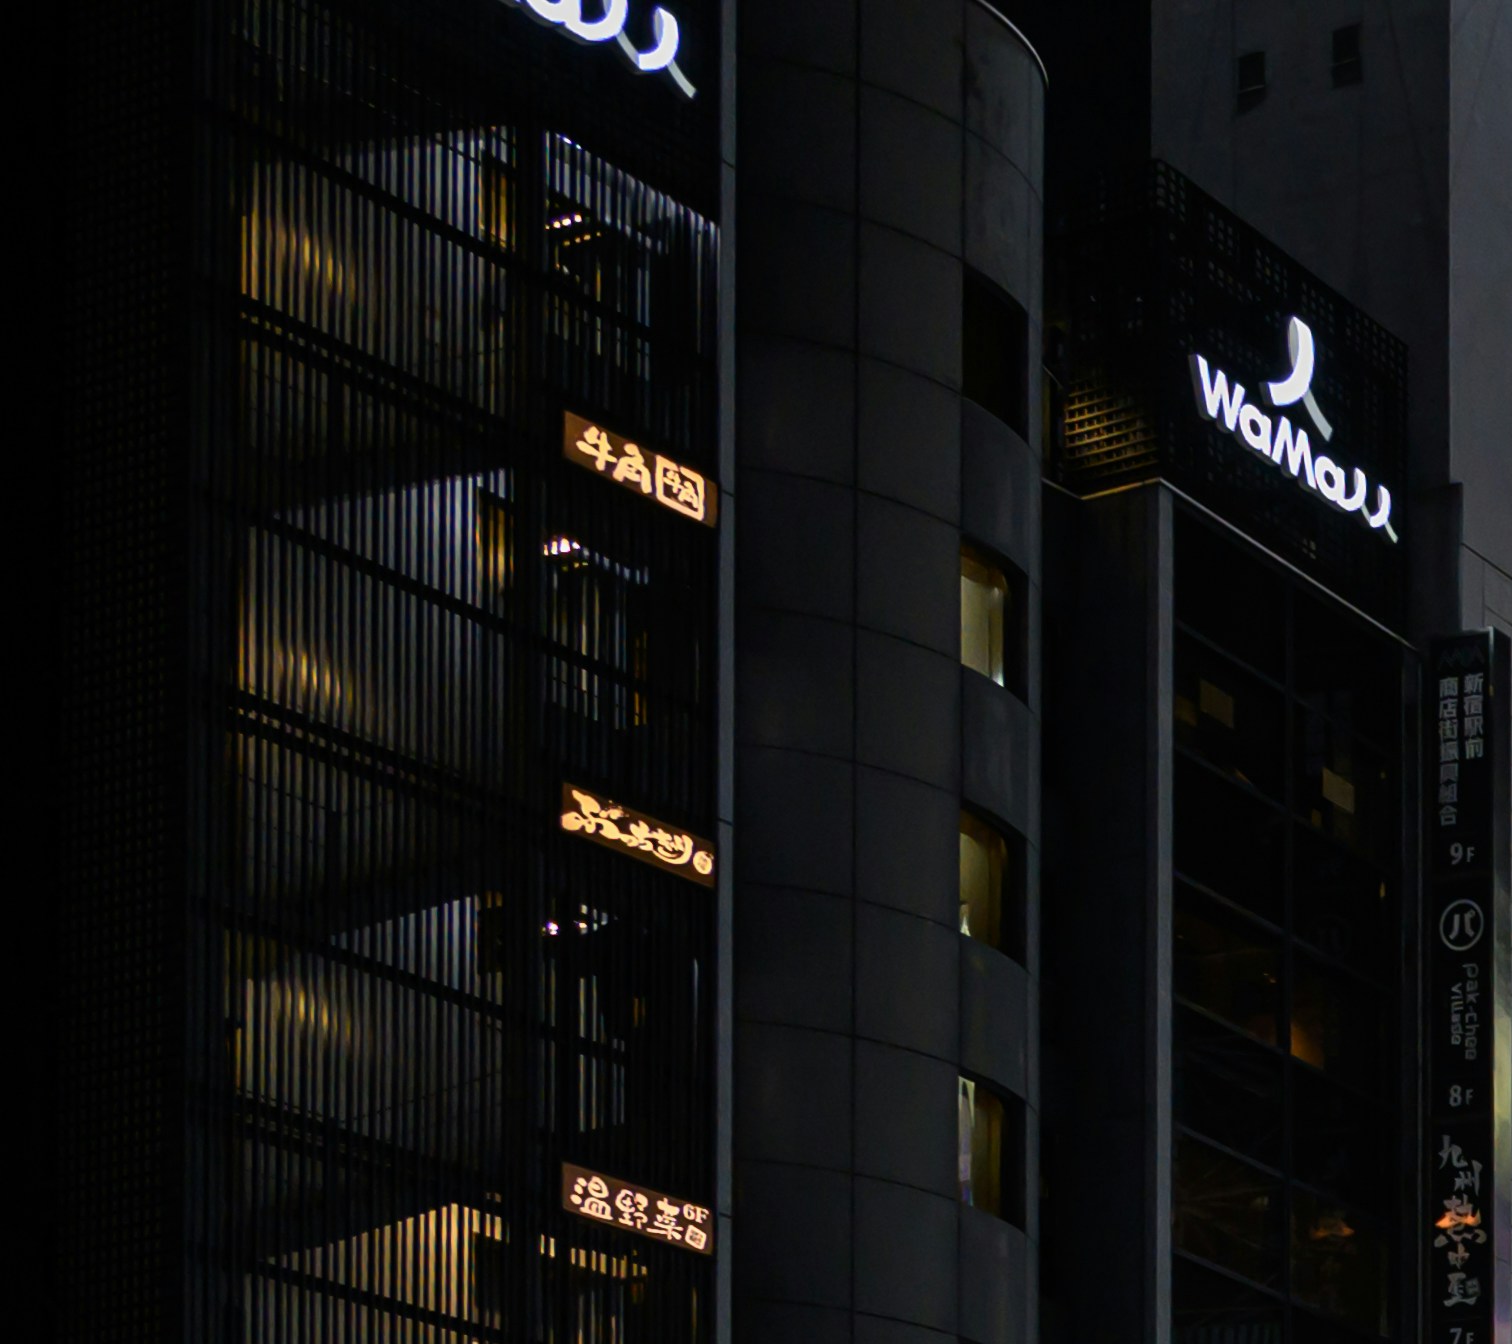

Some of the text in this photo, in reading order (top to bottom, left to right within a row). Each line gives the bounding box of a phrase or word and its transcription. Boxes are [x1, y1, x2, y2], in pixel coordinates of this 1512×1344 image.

[1448, 842, 1476, 865] 9F
[1448, 1085, 1475, 1107] 8F
[683, 1203, 711, 1226] 6F
